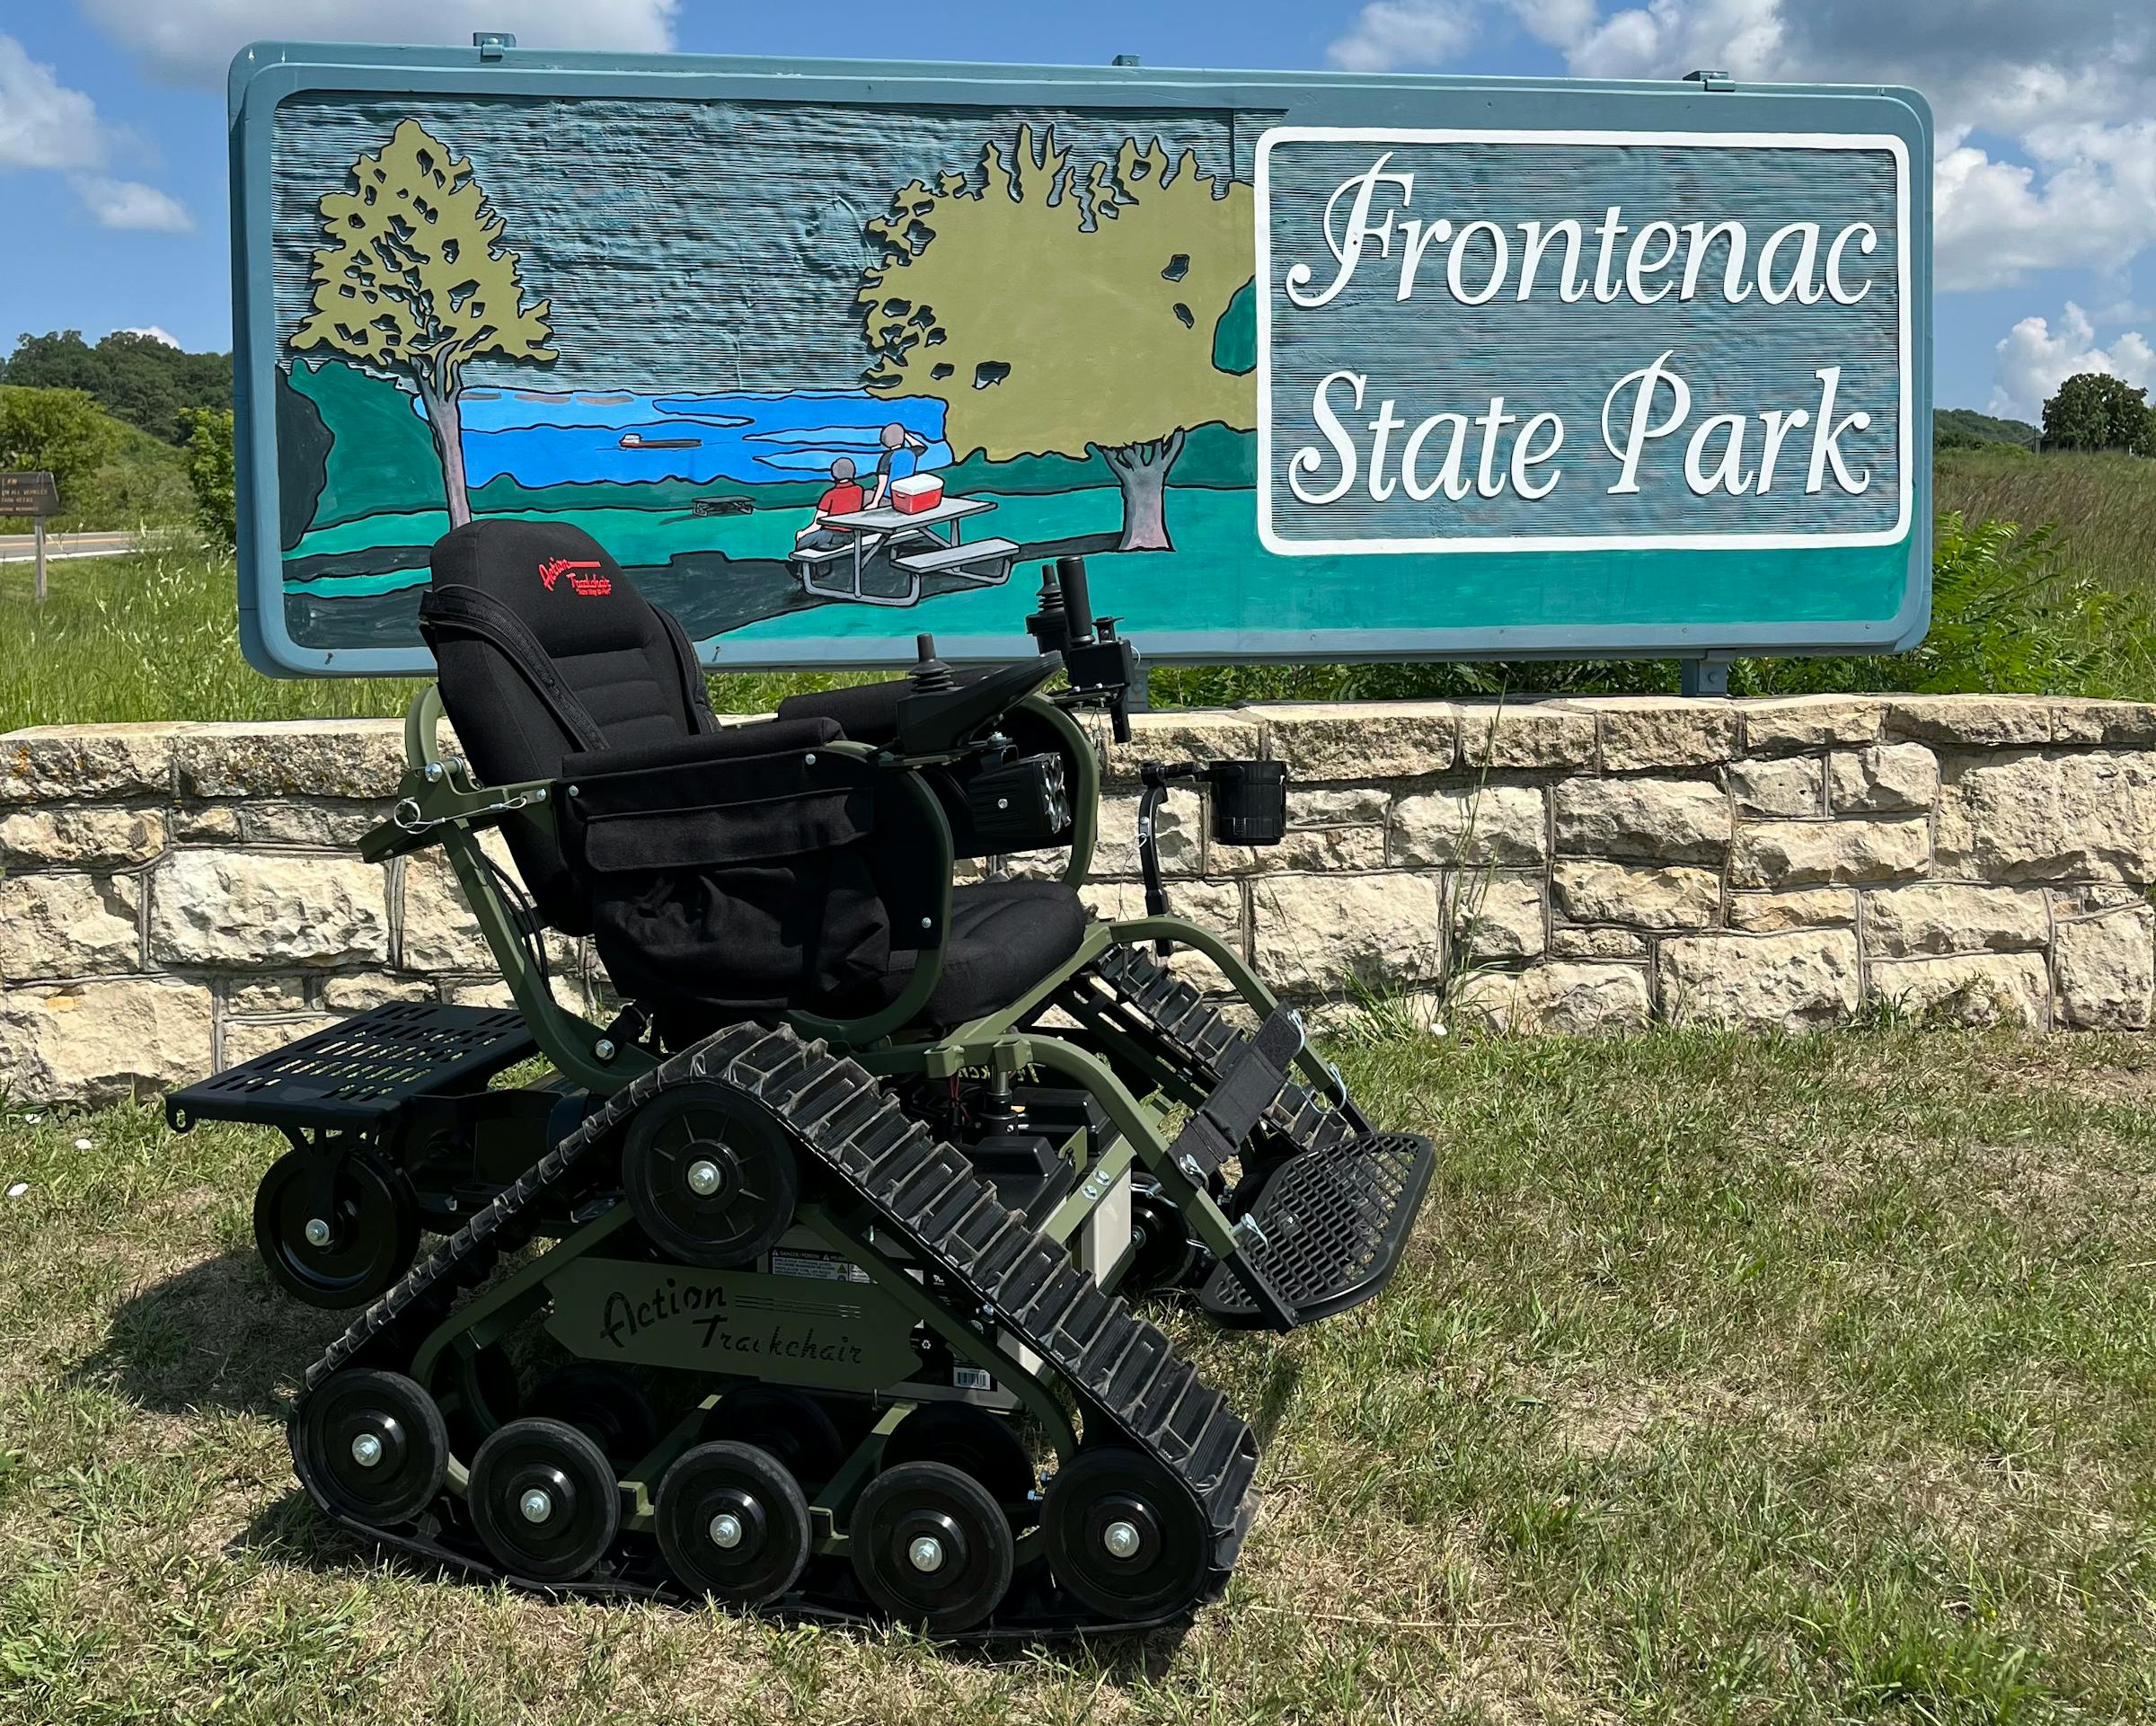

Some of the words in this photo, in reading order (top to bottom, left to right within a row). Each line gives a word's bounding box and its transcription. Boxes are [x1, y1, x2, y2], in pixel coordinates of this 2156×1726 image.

[1286, 152, 1878, 307] Frontenac
[1288, 369, 1567, 505] State
[1601, 349, 1872, 498] Park
[539, 556, 572, 591] Action
[600, 1277, 728, 1349] Action
[692, 1314, 862, 1364] Trackchair
